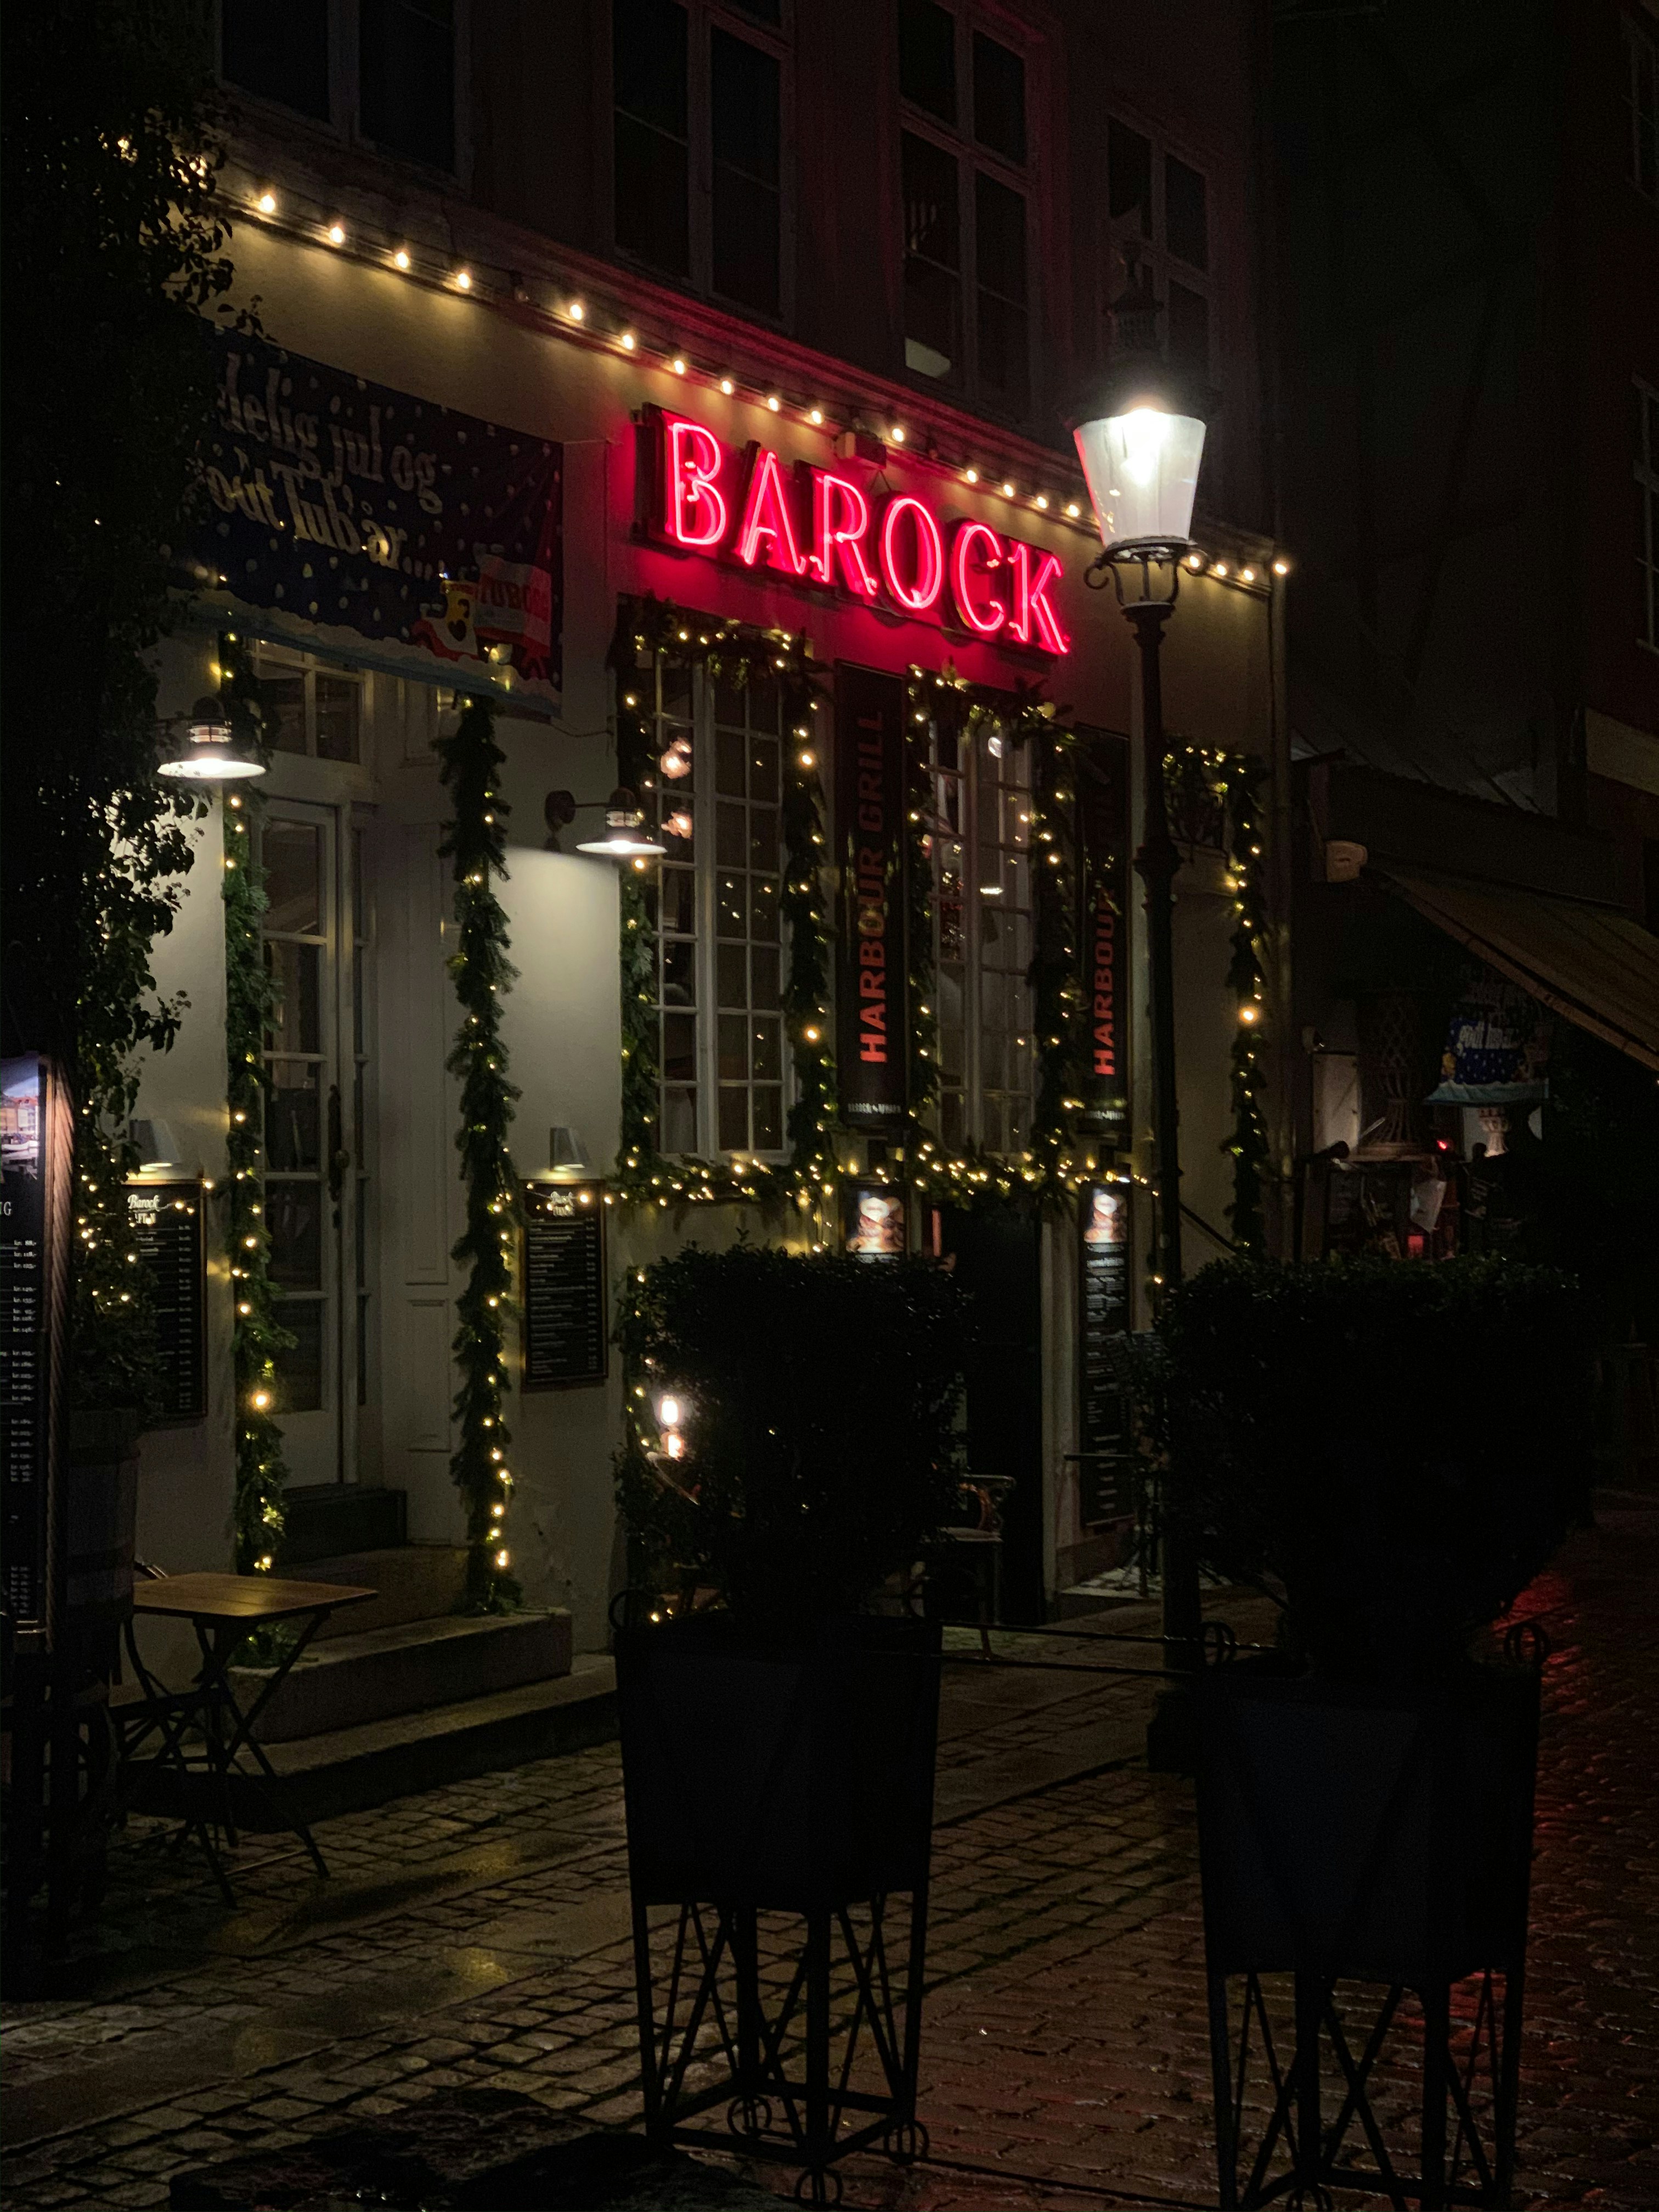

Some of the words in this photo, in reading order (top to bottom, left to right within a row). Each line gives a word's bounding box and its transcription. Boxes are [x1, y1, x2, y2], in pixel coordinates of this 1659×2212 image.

[328, 404, 384, 487] jul
[391, 445, 442, 514] og
[663, 410, 1070, 654] BAROCK
[856, 711, 884, 832] GRILL
[856, 846, 889, 1063] HARBOUR
